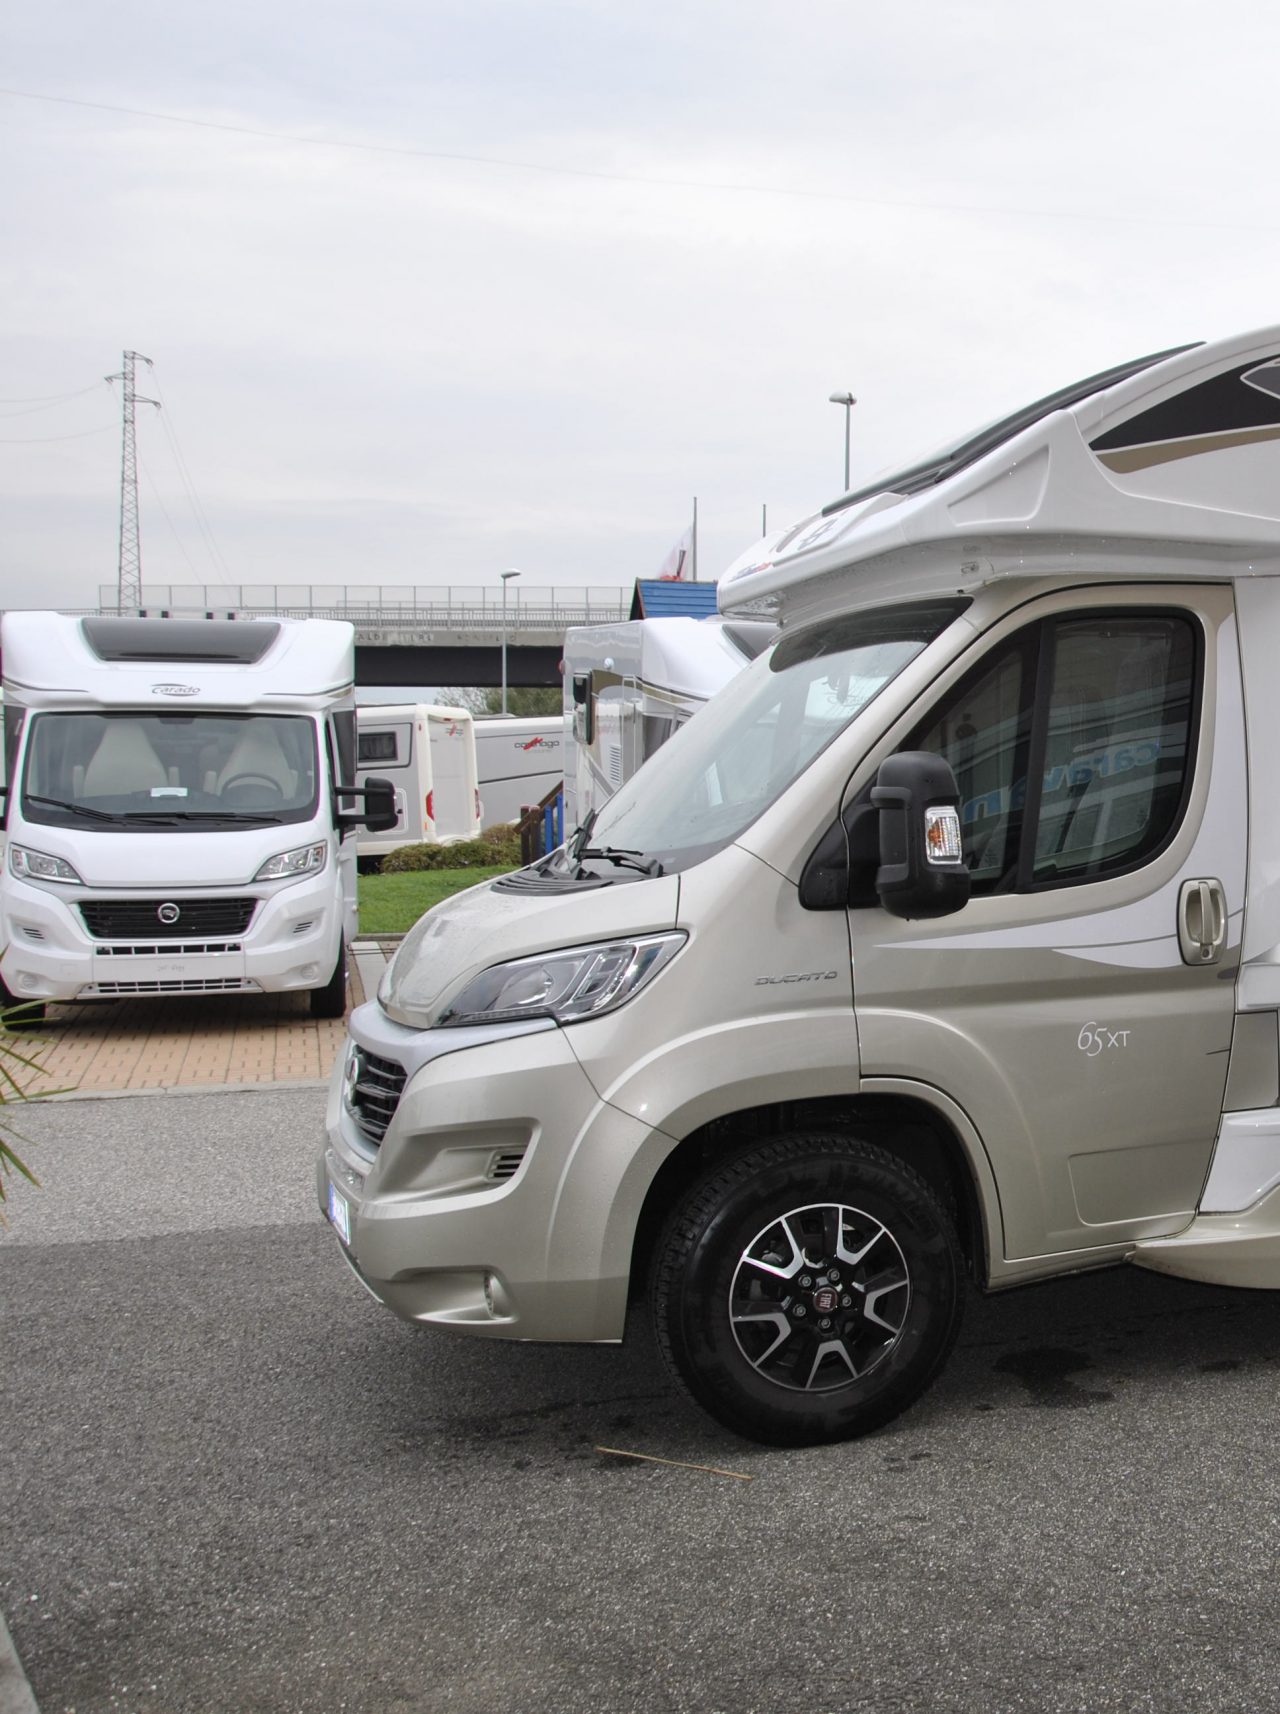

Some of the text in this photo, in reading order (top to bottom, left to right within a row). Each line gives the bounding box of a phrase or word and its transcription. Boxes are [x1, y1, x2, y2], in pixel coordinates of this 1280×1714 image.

[514, 737, 560, 750] caago
[754, 971, 838, 986] DUCATO
[819, 1293, 832, 1309] FIAT
